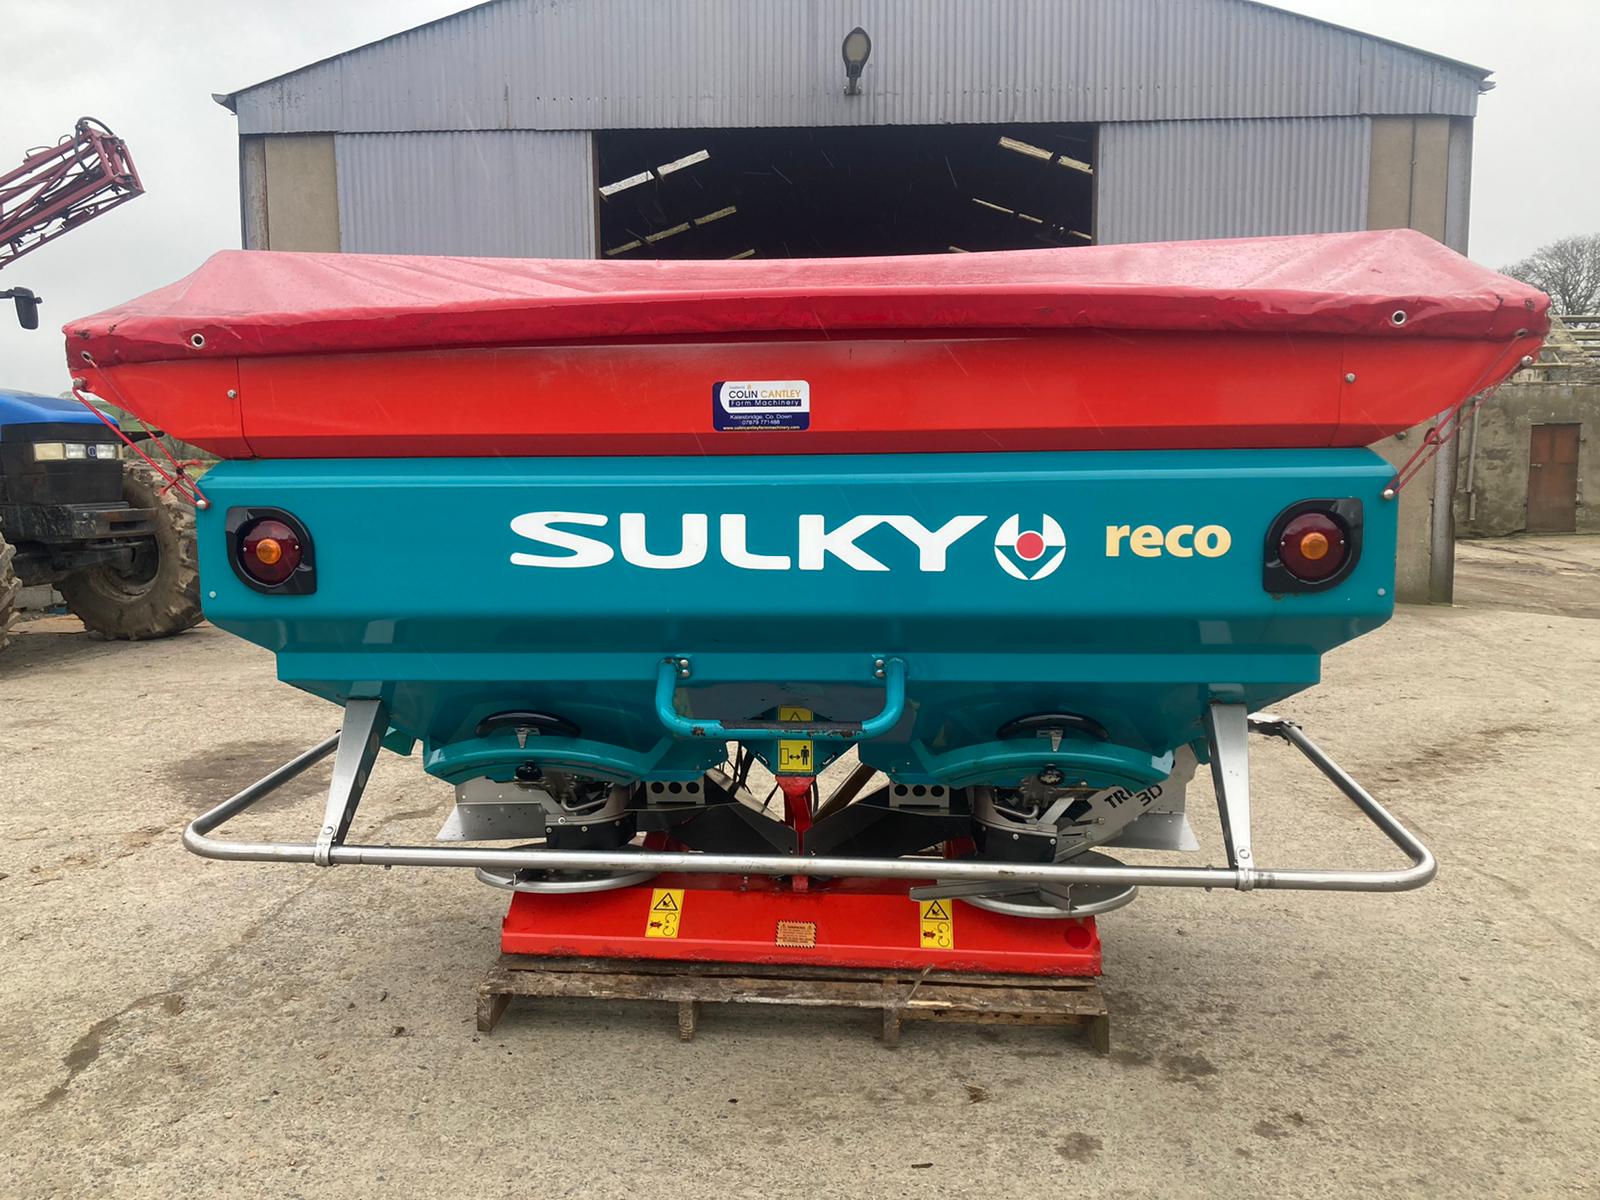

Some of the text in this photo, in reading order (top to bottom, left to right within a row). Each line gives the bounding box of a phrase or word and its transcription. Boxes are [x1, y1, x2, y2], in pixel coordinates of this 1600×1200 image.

[729, 389, 801, 399] COLIN CANTLEY
[731, 399, 799, 407] Farm Machinery
[510, 511, 988, 572] SULKY
[1106, 522, 1232, 558] reco
[1136, 784, 1163, 807] 3D
